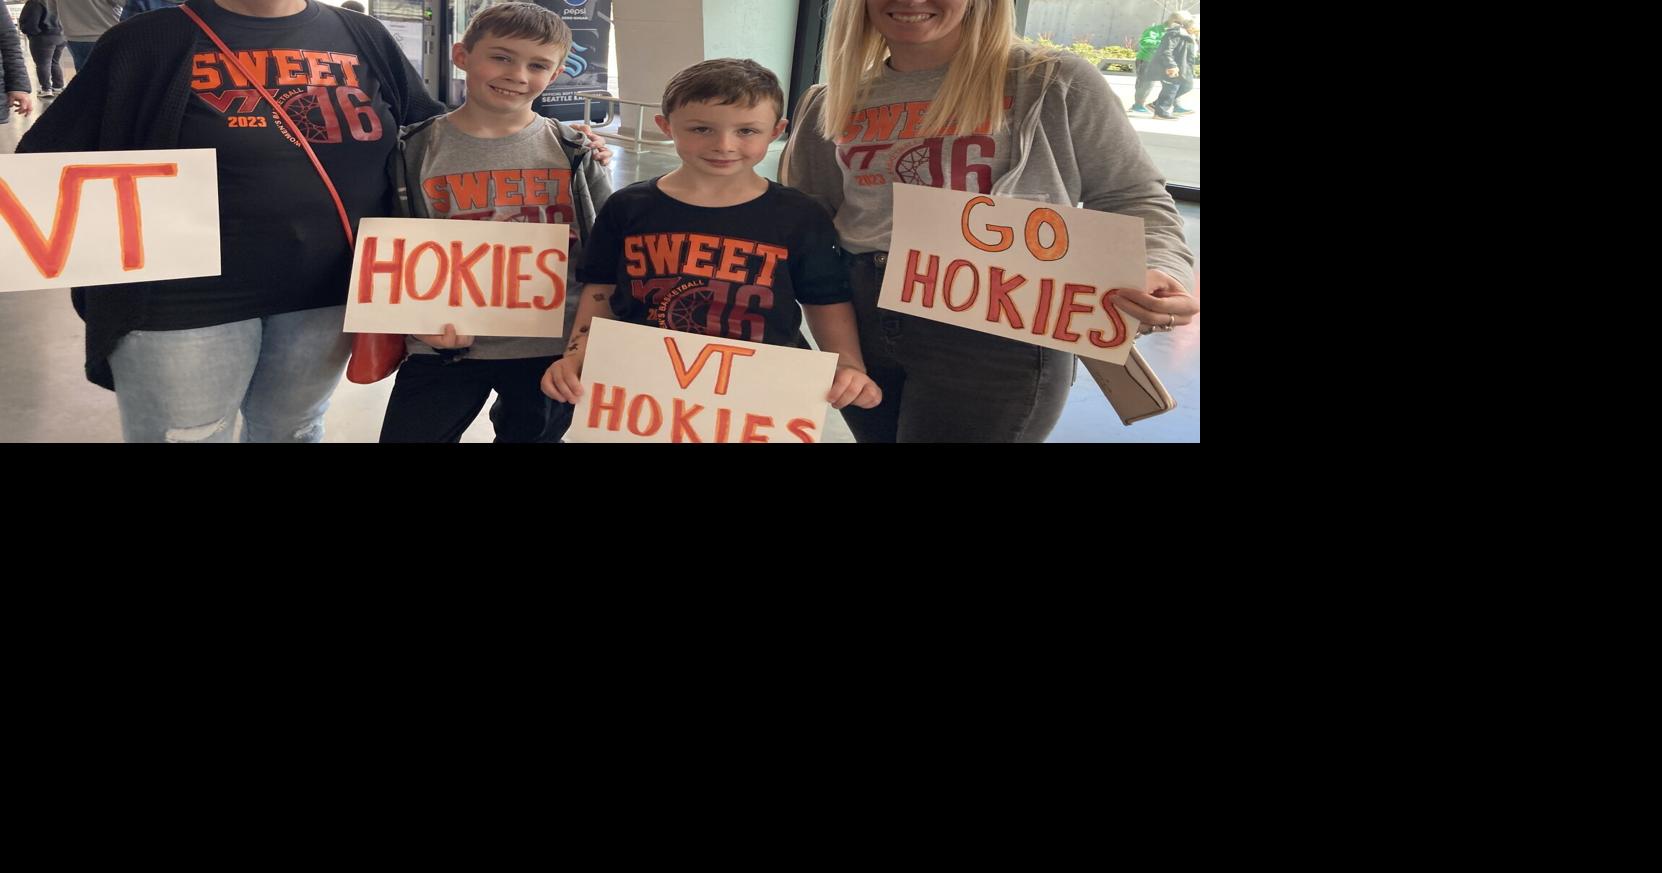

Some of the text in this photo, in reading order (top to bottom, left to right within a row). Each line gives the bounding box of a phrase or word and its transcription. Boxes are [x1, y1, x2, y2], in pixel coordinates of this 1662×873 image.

[190, 49, 360, 90] SWEET
[197, 88, 279, 113] VT
[227, 116, 267, 128] 2023
[306, 85, 382, 143] 16
[541, 95, 573, 103] SEATTLE
[422, 167, 573, 214] SWEET
[923, 136, 996, 194] 16
[0, 163, 178, 278] VT
[961, 196, 1069, 262] GO
[358, 236, 567, 311] HOKIES
[624, 232, 789, 288] SWEET
[707, 279, 775, 343] 16
[901, 249, 1128, 348] HOKIES
[664, 336, 756, 396] VT
[587, 382, 818, 443] HOKIES
